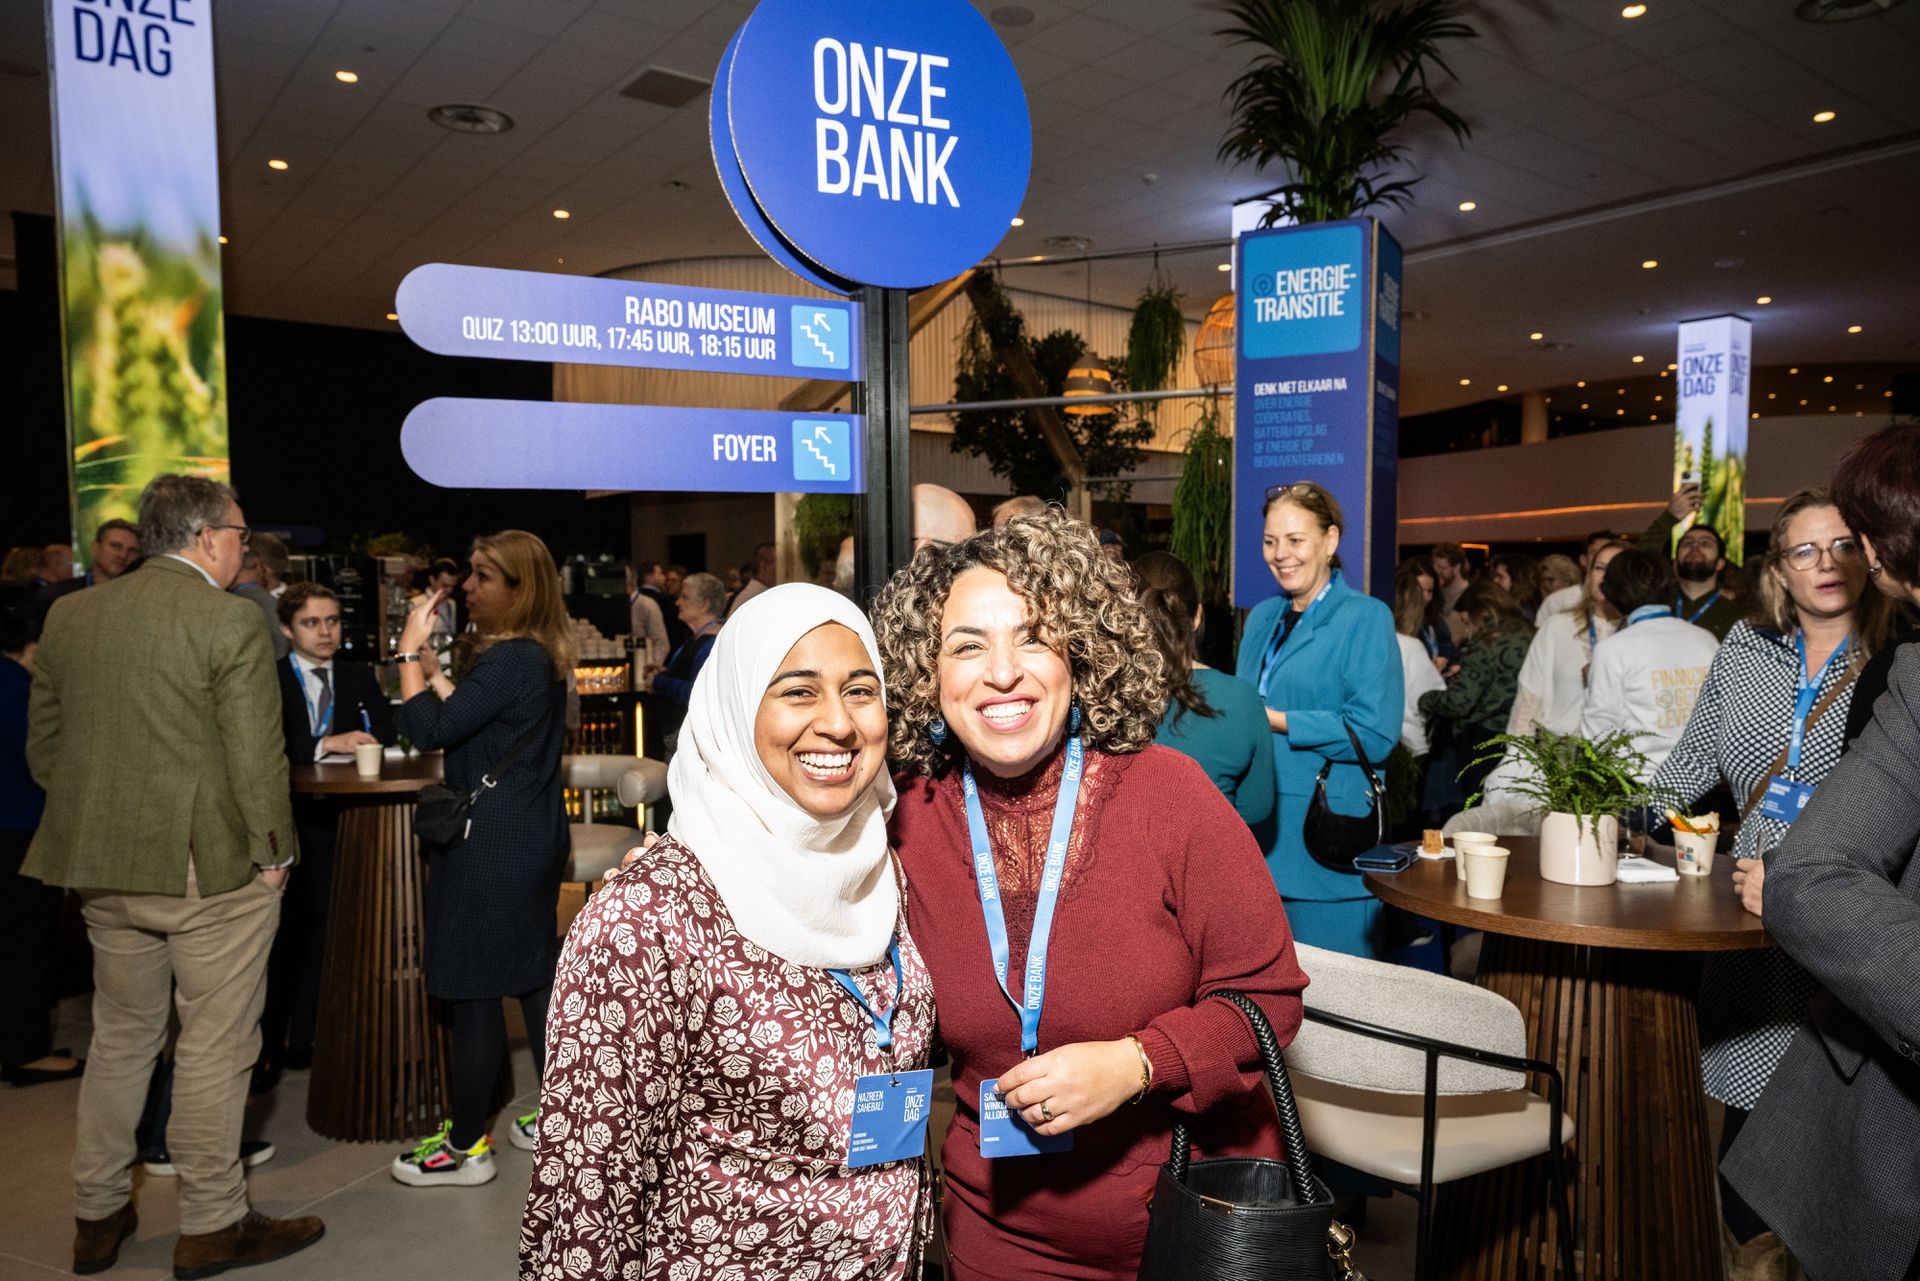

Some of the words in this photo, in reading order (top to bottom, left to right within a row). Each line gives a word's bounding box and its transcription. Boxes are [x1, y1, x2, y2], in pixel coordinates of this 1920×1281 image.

[73, 6, 171, 77] DAG
[813, 37, 950, 130] ONZE
[815, 117, 961, 208] BANK
[1276, 263, 1357, 296] ENERGIE-
[624, 296, 683, 328] RABO
[687, 301, 776, 336] MUSEUM
[1253, 290, 1345, 323] TRANSITIE
[462, 316, 504, 341] QUIZ
[508, 319, 559, 345] 13:00
[562, 324, 601, 350] UUR,
[607, 327, 652, 352] 17:45
[656, 331, 694, 357] UUR,
[698, 334, 742, 358] 18:15
[744, 337, 776, 361] UUR
[1683, 352, 1724, 377] ONZE
[1254, 382, 1278, 396] DENK
[1278, 380, 1297, 394] MET
[1298, 378, 1332, 393] ELKAAR
[1333, 377, 1347, 391] NA
[1683, 376, 1716, 397] DAG
[713, 434, 777, 462] FOYER
[1066, 757, 1081, 781] ONZE
[976, 852, 992, 877] ONZE
[1050, 840, 1065, 866] BANK
[981, 876, 997, 901] BANK
[1044, 866, 1060, 891] ONZE
[1030, 955, 1043, 983] BANK
[1027, 983, 1041, 1010] ONZE
[904, 1094, 925, 1109] ONZE
[903, 1108, 920, 1123] DAG
